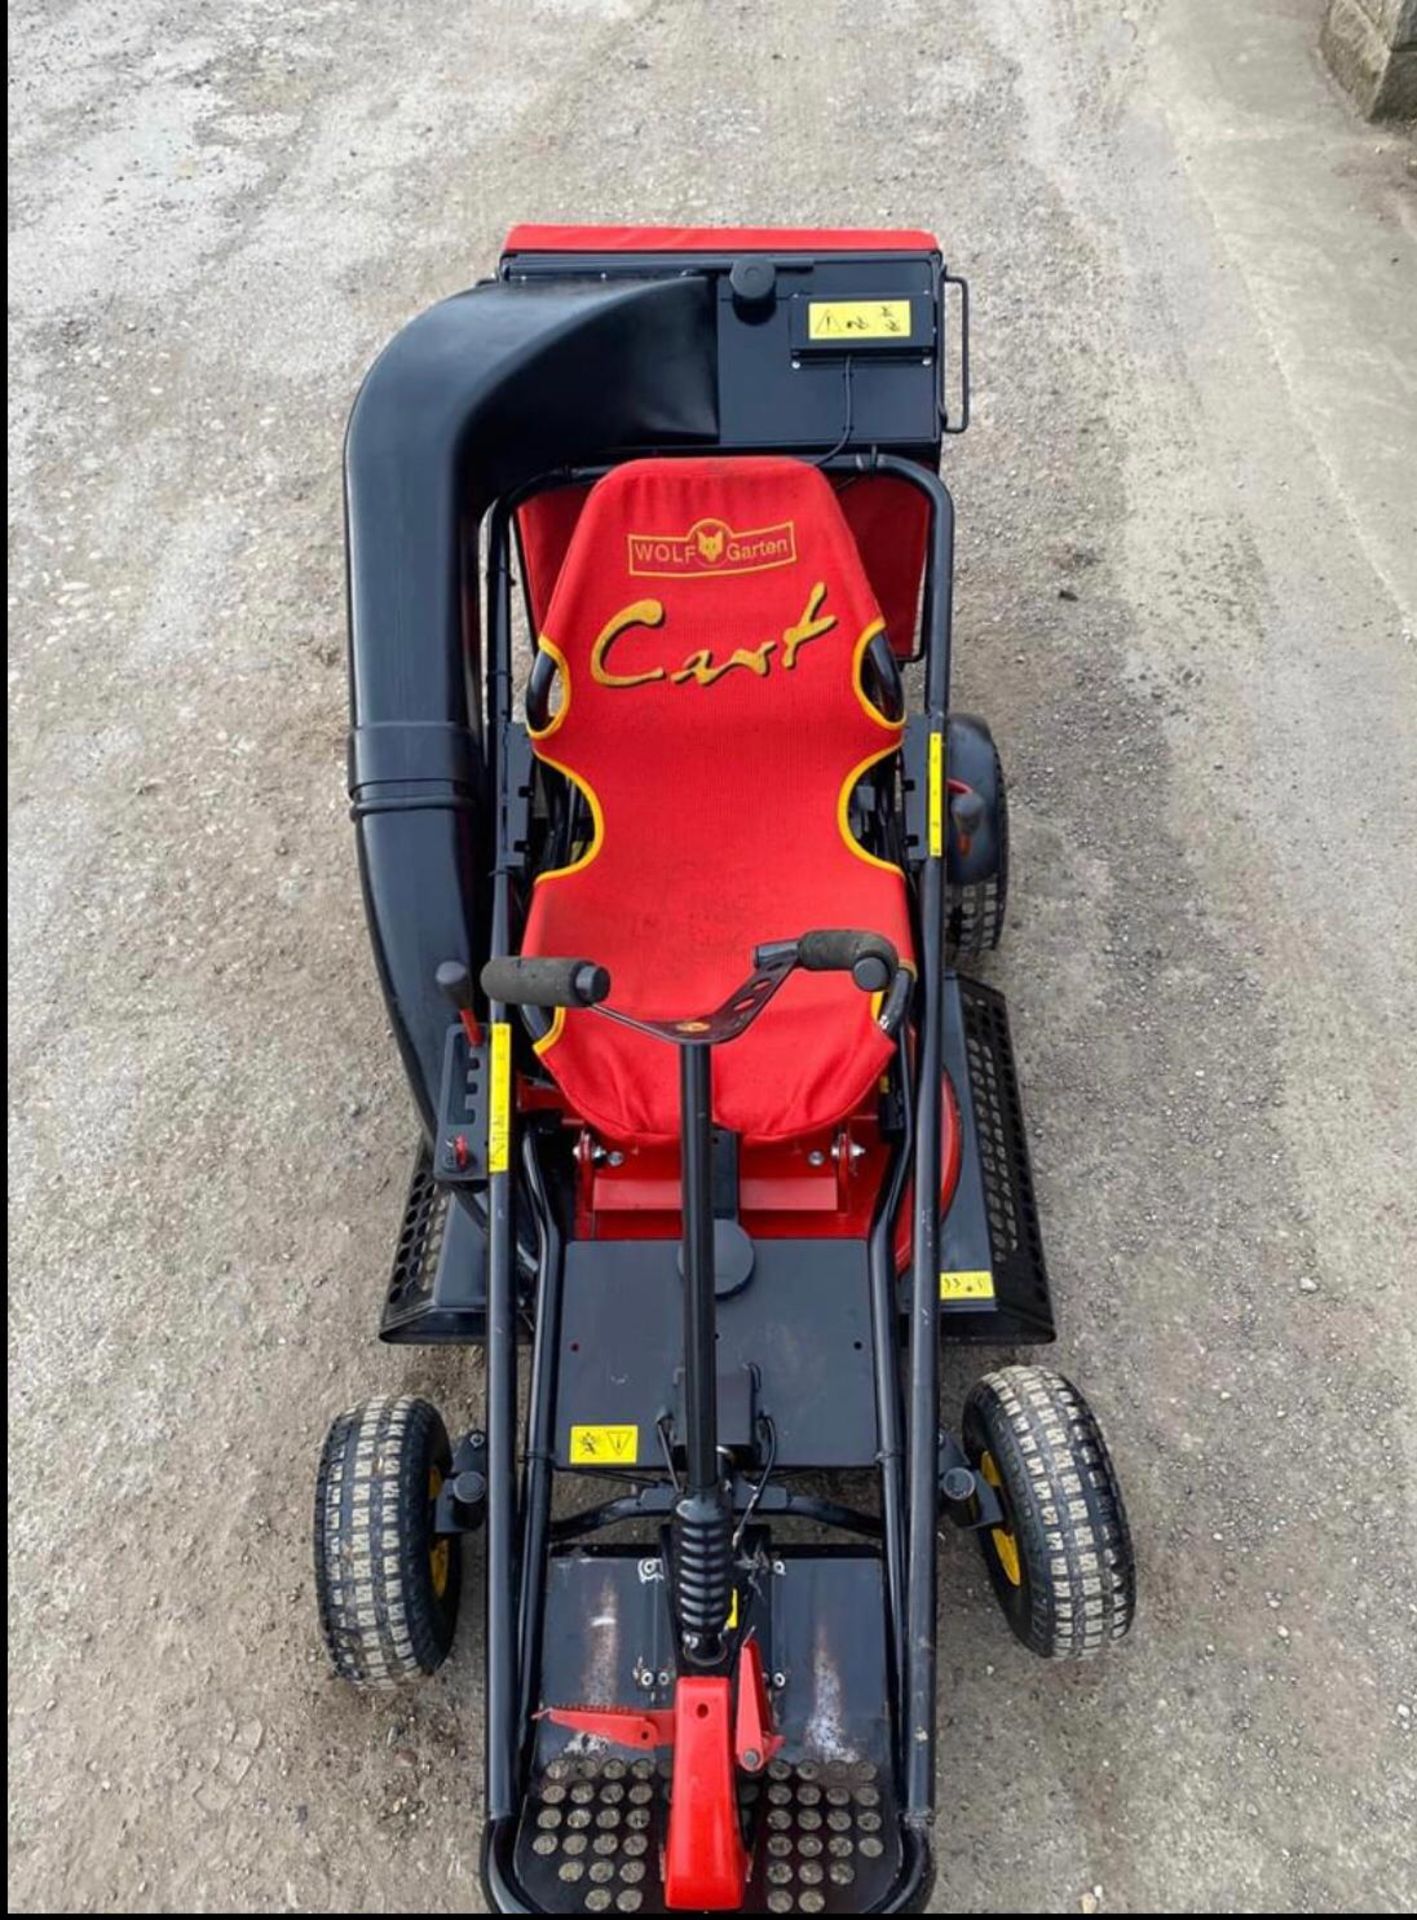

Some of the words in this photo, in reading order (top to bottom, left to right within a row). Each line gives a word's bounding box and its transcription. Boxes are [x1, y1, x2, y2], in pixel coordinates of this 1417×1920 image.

[634, 542, 696, 564] WOLF
[726, 538, 788, 562] Garten
[590, 582, 838, 687] Cart
